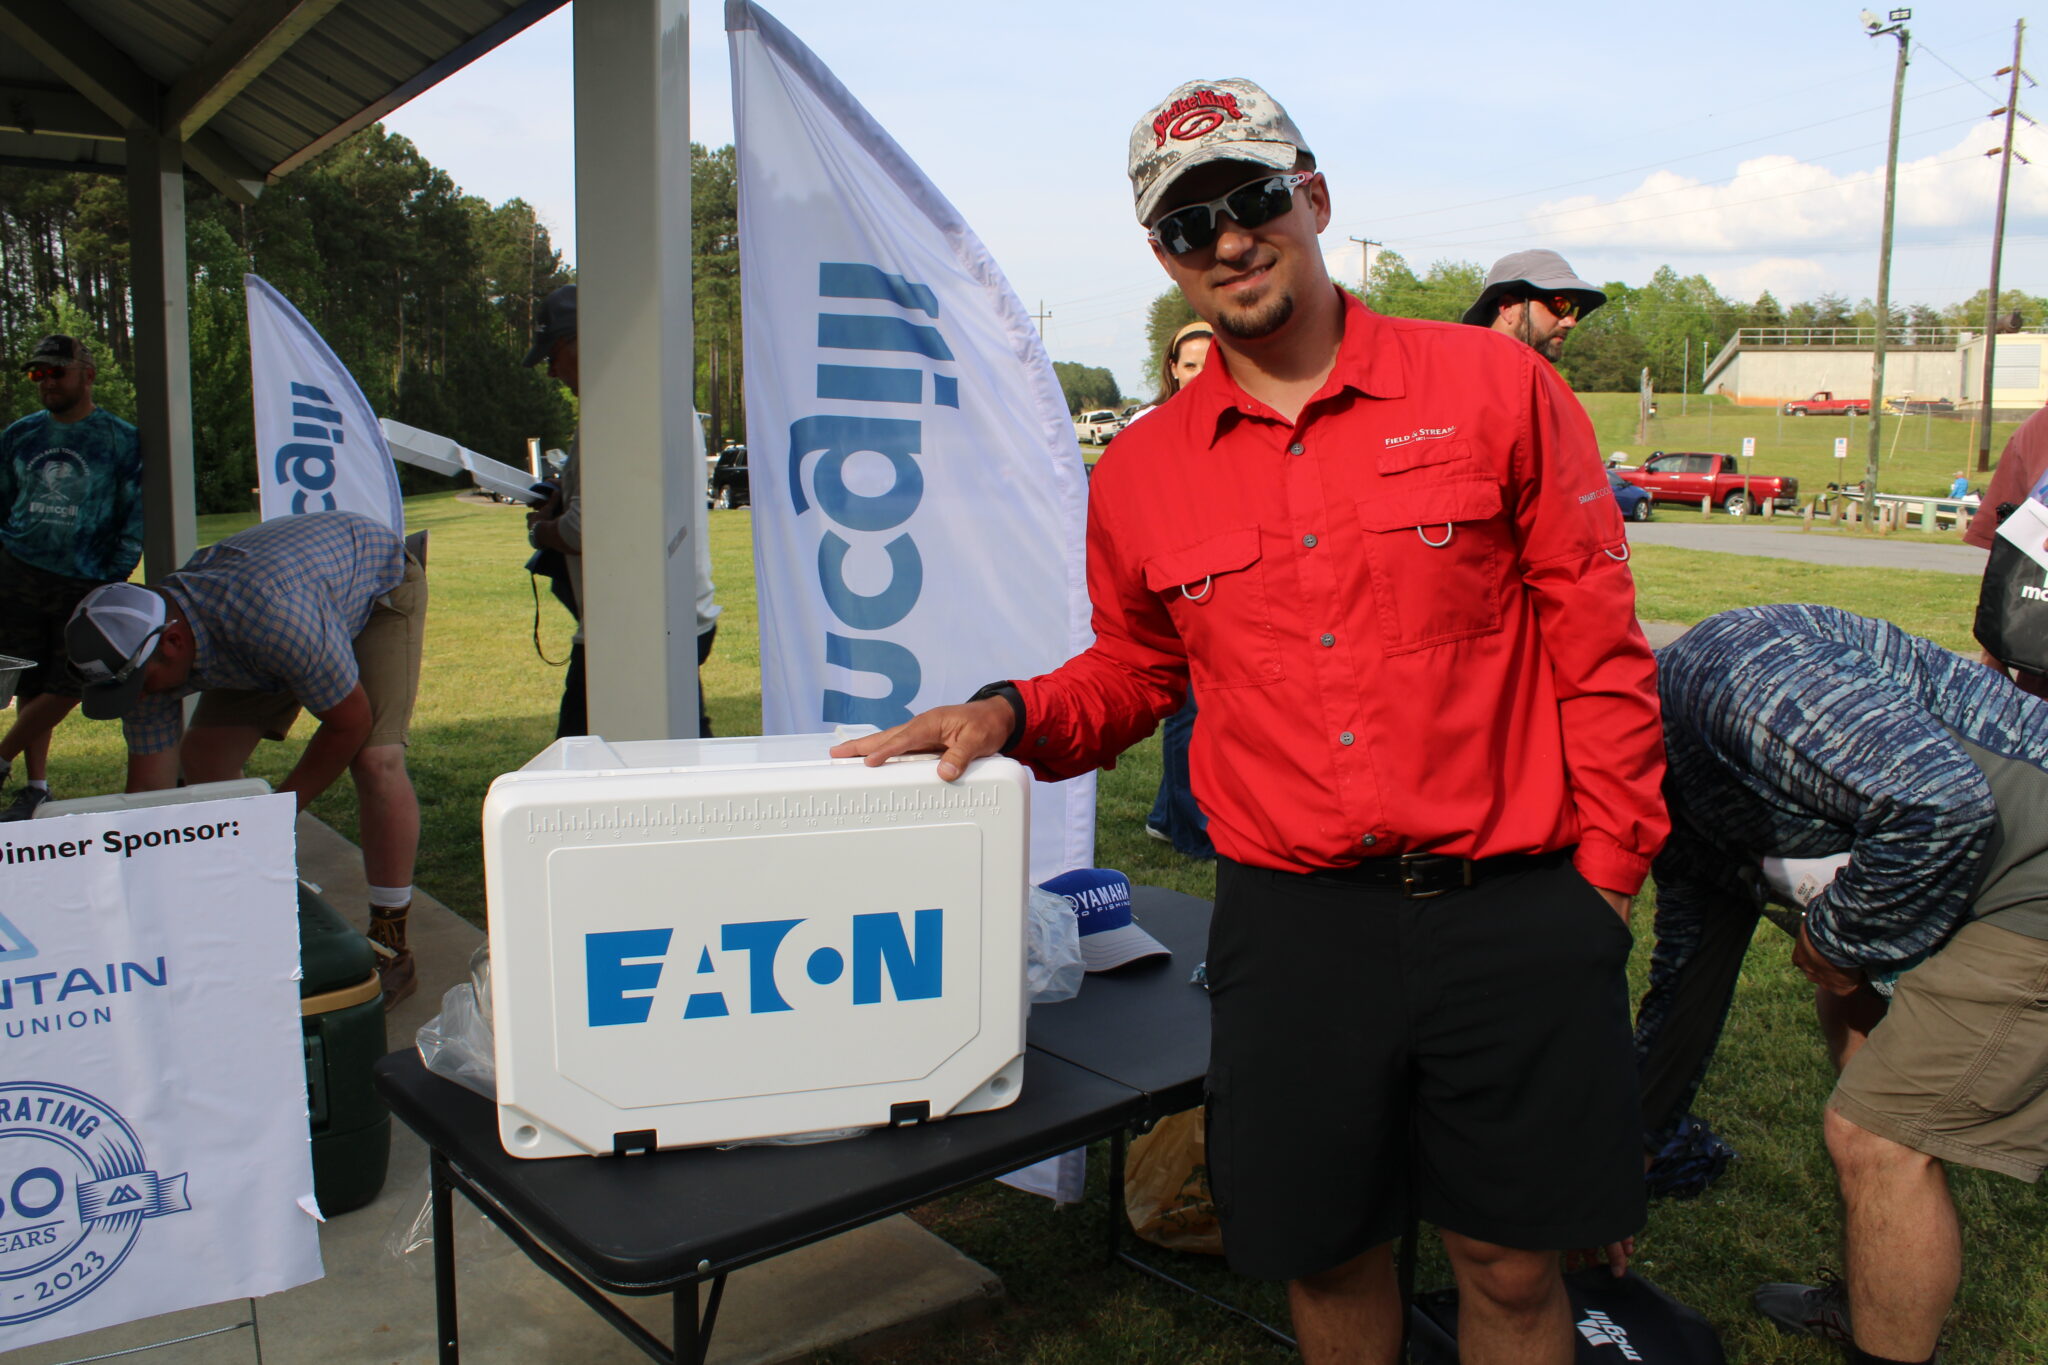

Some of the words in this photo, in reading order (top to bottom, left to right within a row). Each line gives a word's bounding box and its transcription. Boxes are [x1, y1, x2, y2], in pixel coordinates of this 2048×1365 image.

[1153, 96, 1199, 148] Strike
[1195, 90, 1243, 119] King
[275, 381, 344, 514] cgill
[1385, 435, 1410, 445] FIELD
[45, 505, 79, 517] mcgill
[807, 818, 817, 827] 10
[833, 816, 844, 825] 11
[860, 815, 871, 824] 12
[887, 813, 897, 822] 13
[913, 811, 924, 820] 14
[938, 809, 949, 818] 15
[964, 808, 975, 817] 16
[990, 807, 1000, 816] 17
[0, 838, 92, 865] inner
[102, 821, 240, 858] Sponsor:
[1076, 882, 1129, 909] YAMAHA
[585, 908, 944, 1028] EATON
[6, 1006, 112, 1038] UNION
[0, 1166, 64, 1219] 0
[34, 1250, 105, 1301] 2023
[1585, 1309, 1643, 1361] mcgill
